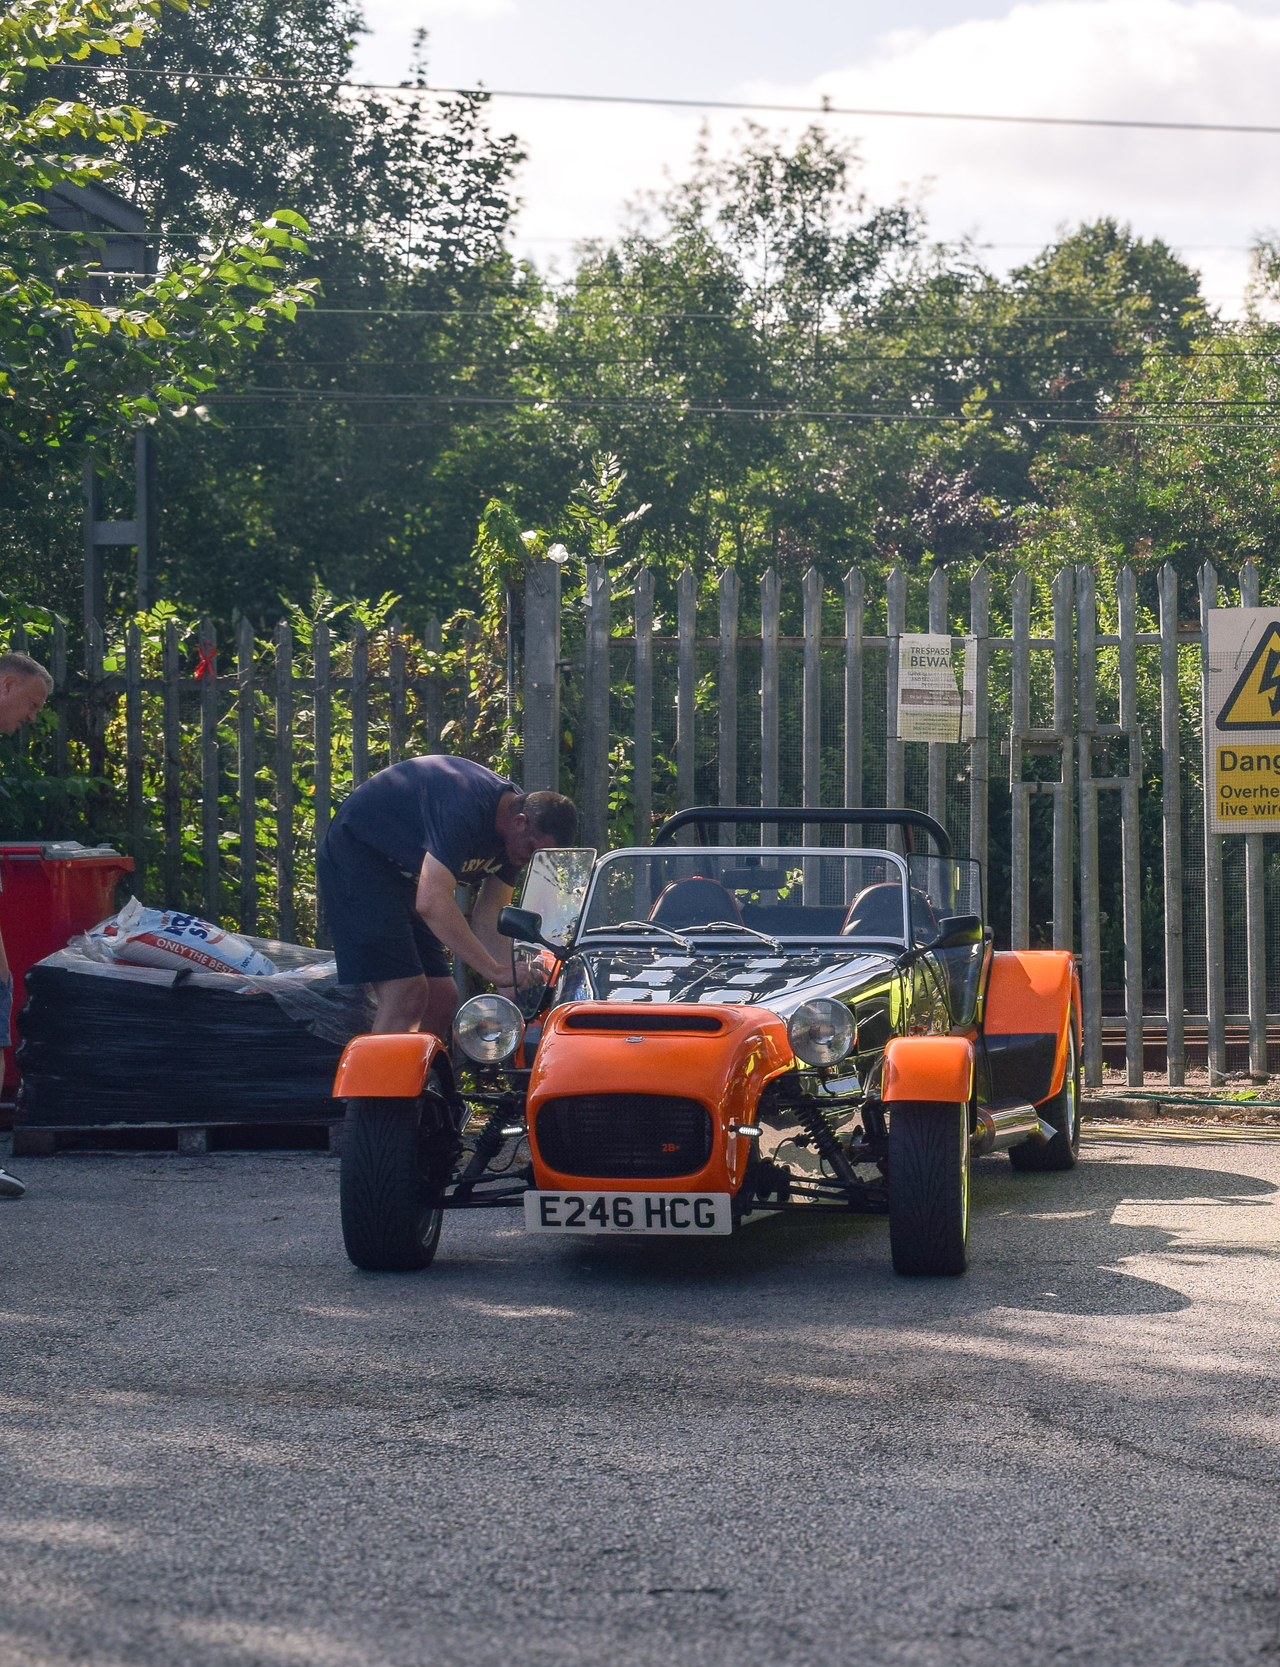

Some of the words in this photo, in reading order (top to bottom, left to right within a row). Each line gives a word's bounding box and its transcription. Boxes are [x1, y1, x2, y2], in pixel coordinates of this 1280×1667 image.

[1220, 802, 1248, 816] live
[157, 938, 189, 955] ONLY
[188, 948, 210, 964] THE
[208, 958, 234, 974] BEST
[540, 1196, 634, 1228] E246
[646, 1198, 715, 1229] HCG
